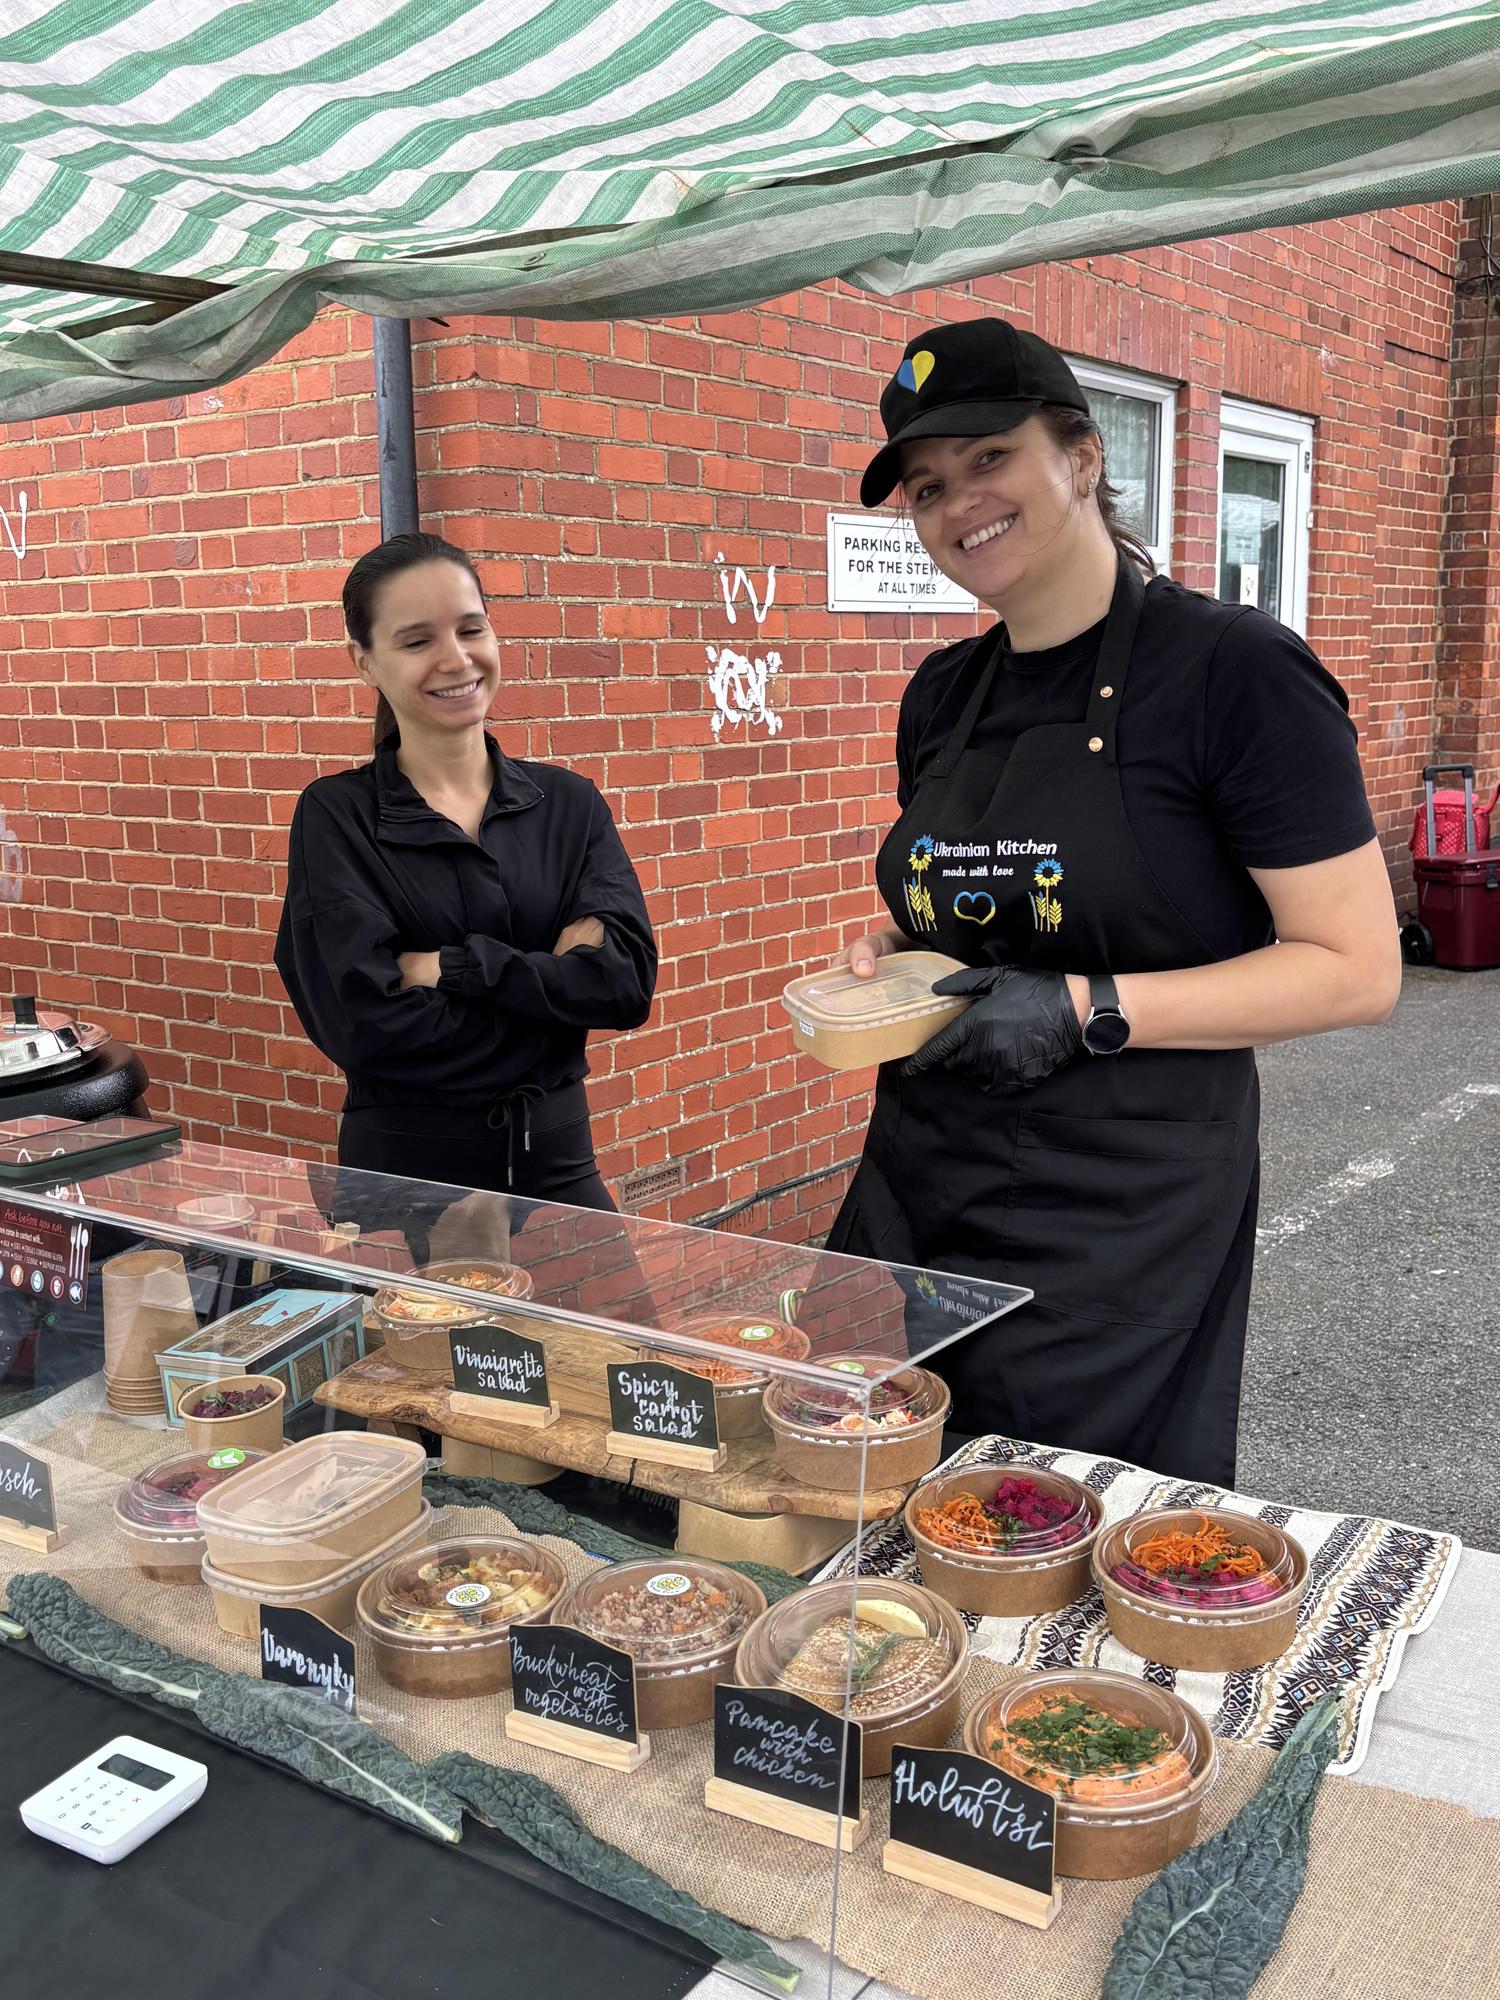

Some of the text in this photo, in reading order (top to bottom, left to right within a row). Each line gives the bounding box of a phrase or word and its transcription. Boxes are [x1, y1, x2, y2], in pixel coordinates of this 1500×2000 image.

[844, 537, 900, 552] PARKING
[849, 559, 944, 576] FOR THE STEW
[878, 582, 936, 595] AT ALL TIMES
[933, 839, 1058, 857] Ukrainian Kitchen
[942, 865, 1014, 877] made with love
[4, 1208, 18, 1221] Ask
[18, 1211, 38, 1226] before
[38, 1219, 51, 1232] you
[454, 1345, 545, 1383] Vinaigrette
[478, 1372, 531, 1393] salad
[618, 1371, 679, 1404] Spicy
[639, 1399, 704, 1425] carrot
[633, 1415, 698, 1438] salad
[261, 1627, 355, 1713] Varenyky
[510, 1637, 630, 1691] Buckwheat
[525, 1687, 630, 1732] vegetables
[573, 1685, 617, 1710] with
[725, 1700, 836, 1754] Pancake
[760, 1737, 812, 1765] with
